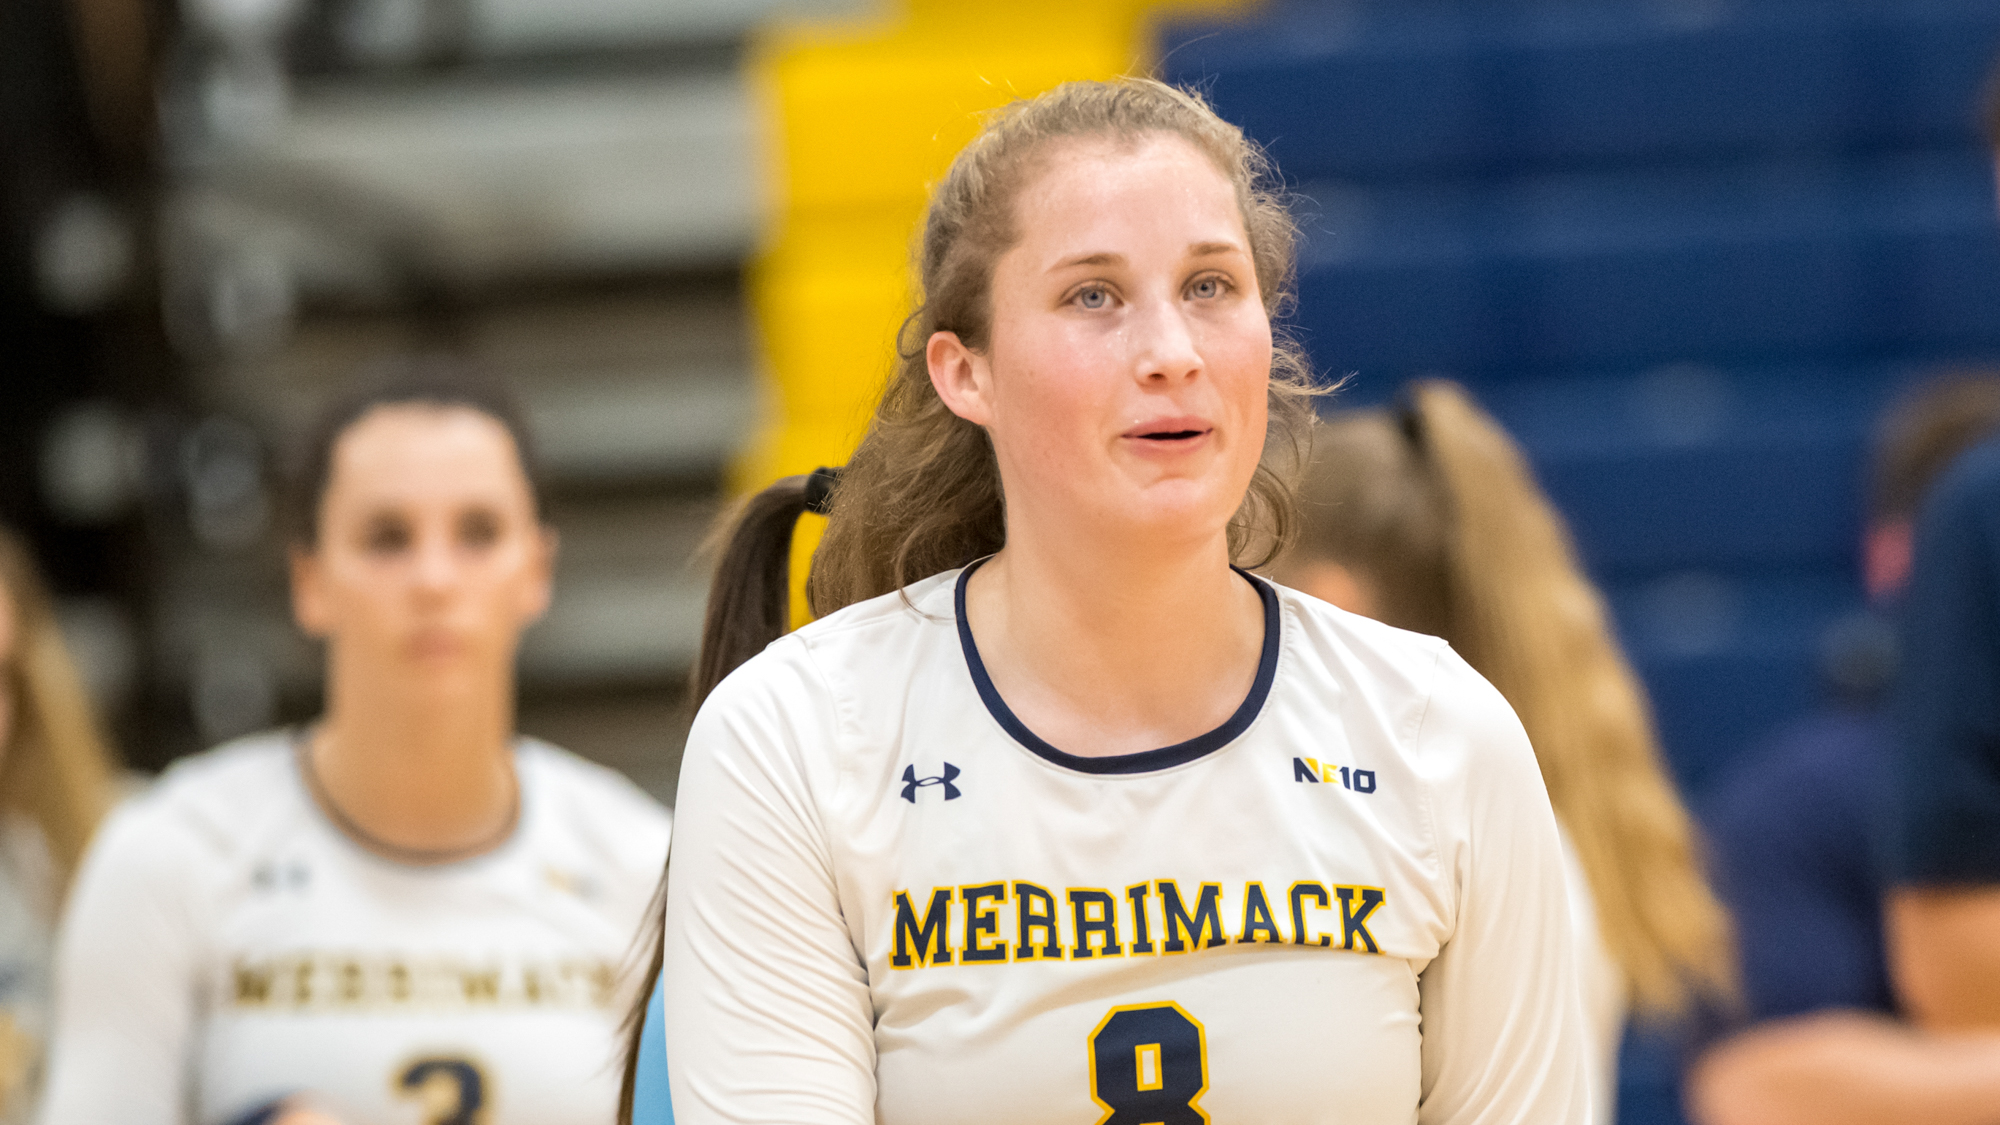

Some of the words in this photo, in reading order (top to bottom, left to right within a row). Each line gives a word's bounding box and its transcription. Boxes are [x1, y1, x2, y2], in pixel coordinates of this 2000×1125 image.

[1293, 757, 1376, 794] NE10
[889, 880, 1386, 969] MERRIMACK
[1087, 1000, 1211, 1125] 8
